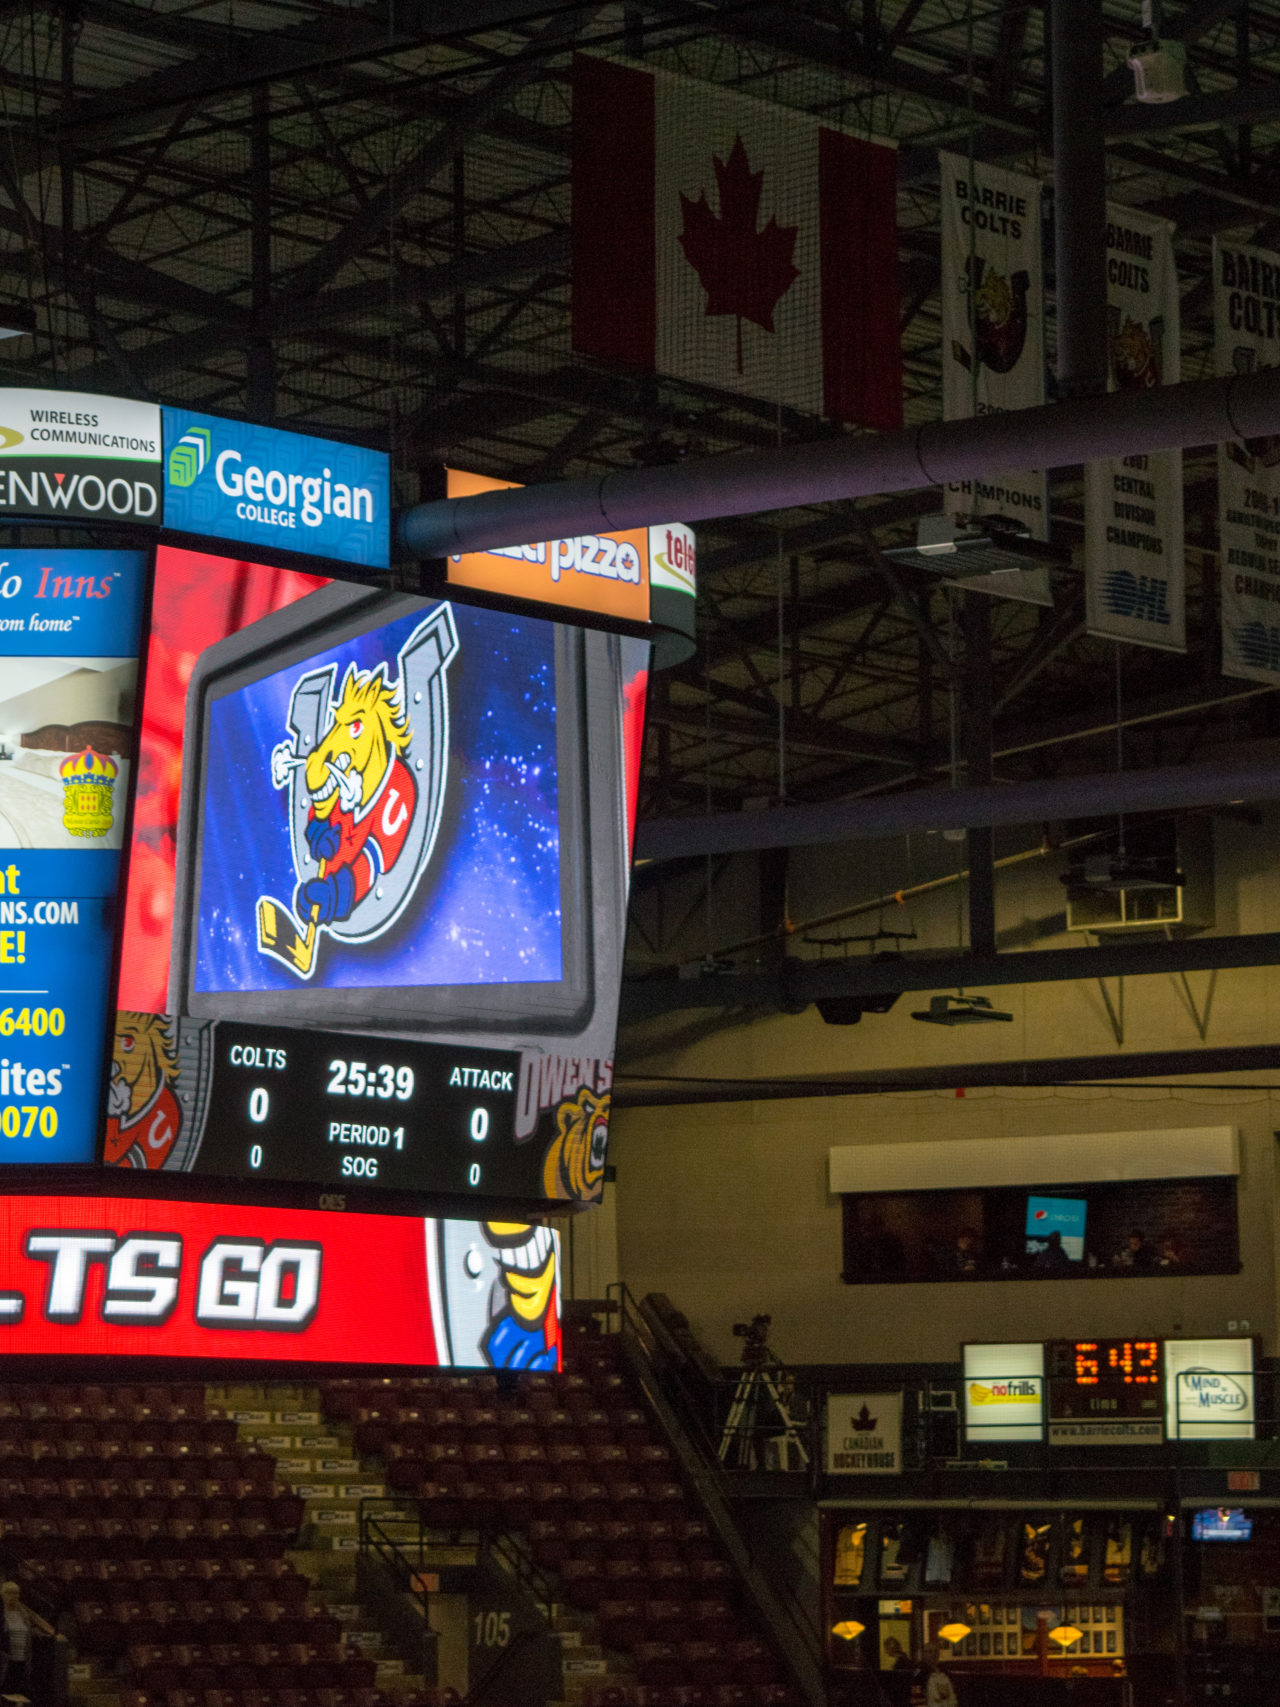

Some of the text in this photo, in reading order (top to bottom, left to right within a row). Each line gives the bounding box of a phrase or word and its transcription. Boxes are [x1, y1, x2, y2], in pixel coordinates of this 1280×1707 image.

[955, 179, 1027, 217] BARRIE
[961, 206, 1023, 240] COLTS
[1108, 258, 1150, 294] COLTS
[30, 409, 99, 428] WIRELESS
[30, 427, 156, 453] COMMUNICATIONS
[215, 449, 374, 528] Georgian
[236, 502, 297, 529] COLLEGE
[33, 567, 114, 600] Inns
[28, 613, 73, 633] home
[230, 1044, 288, 1070] COLTS
[327, 1059, 416, 1101] 25:39
[450, 1066, 515, 1092] ATTACK
[249, 1087, 269, 1123] 0
[329, 1121, 405, 1151] PERIOD 1
[470, 1107, 490, 1143] 0
[251, 1145, 263, 1169] 0
[341, 1156, 379, 1178] SOG
[469, 1162, 481, 1187] 0
[197, 1239, 325, 1327] GO
[473, 1610, 512, 1648] 105
